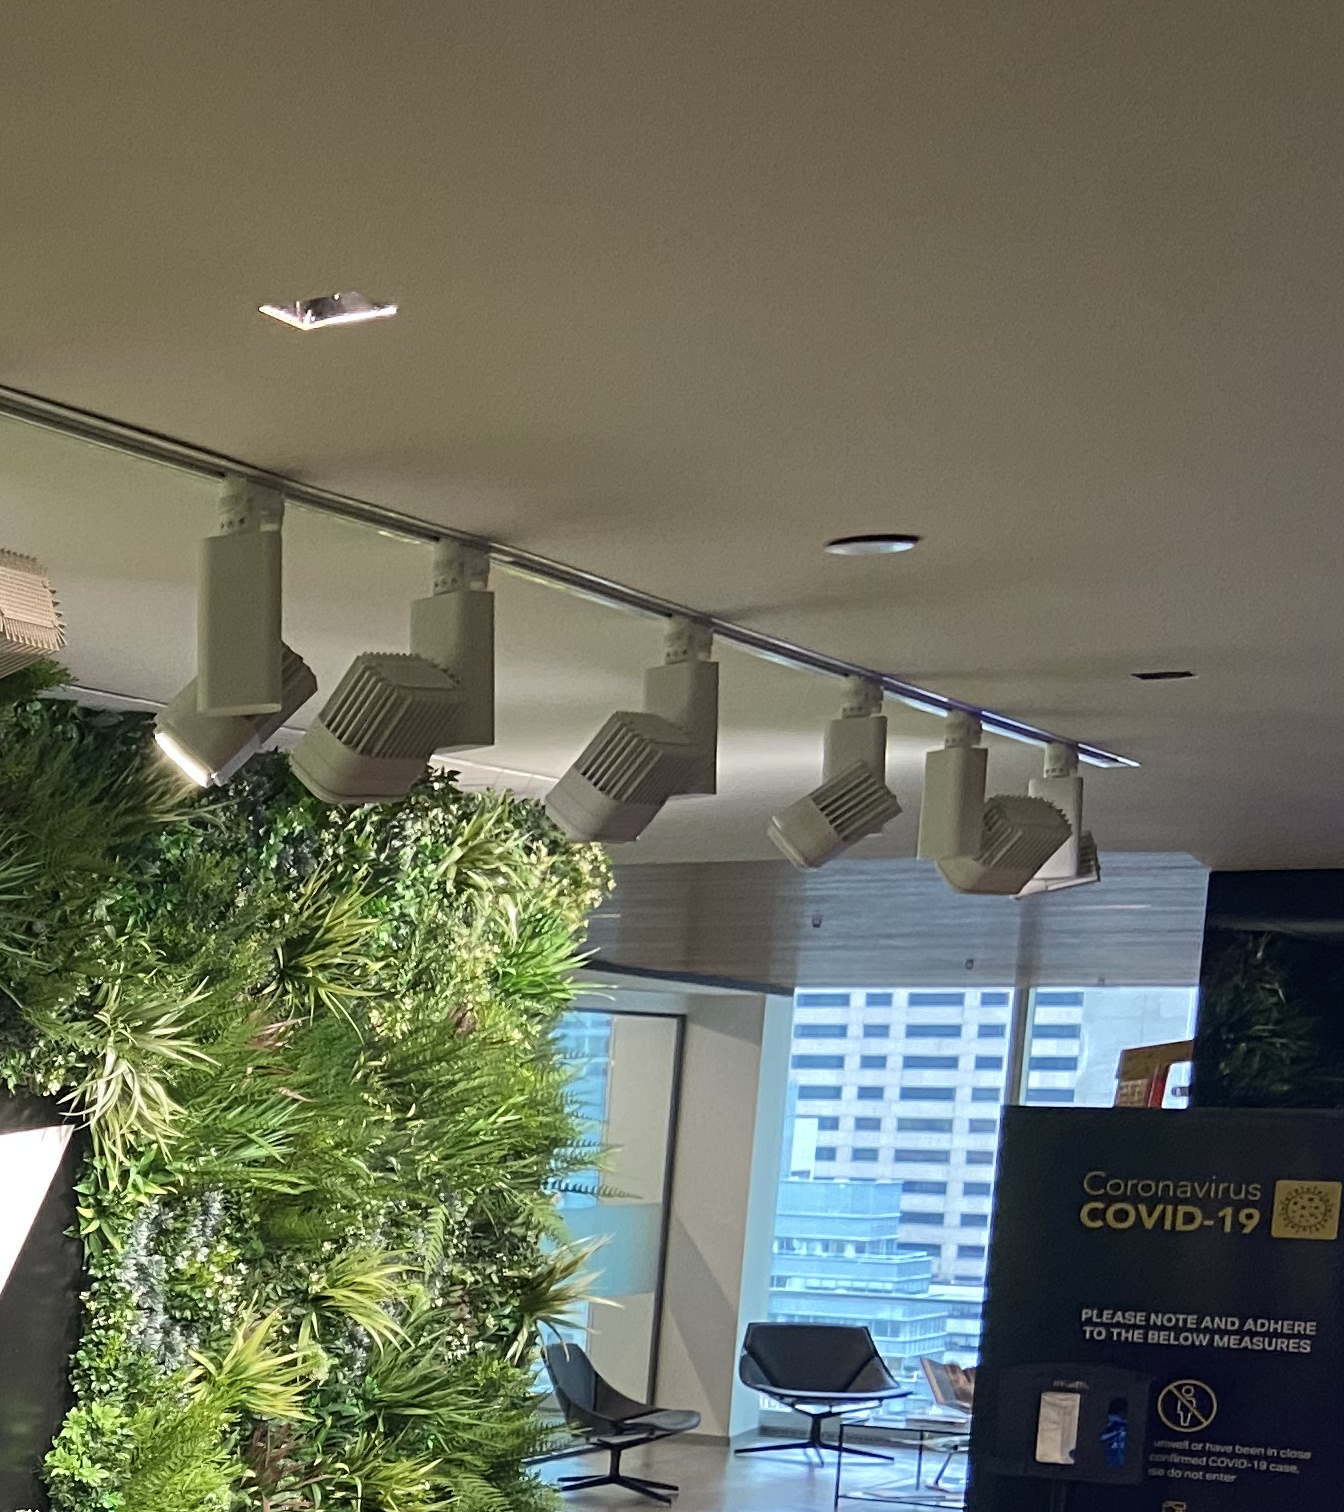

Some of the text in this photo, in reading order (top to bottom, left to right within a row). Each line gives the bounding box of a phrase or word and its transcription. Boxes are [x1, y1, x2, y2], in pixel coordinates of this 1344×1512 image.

[1082, 1171, 1261, 1200] Coronavirus
[1080, 1202, 1260, 1234] COVID-19
[1081, 1309, 1317, 1335] PLEASE NOTE AND ADHERE
[1082, 1326, 1312, 1353] TO THE BELOW MEASURES
[1149, 1453, 1207, 1466] confirmed
[1208, 1456, 1267, 1470] COVID-19
[1190, 1443, 1204, 1451] or
[1205, 1442, 1233, 1453] have
[1234, 1445, 1265, 1456] been
[1266, 1447, 1278, 1457] in
[1279, 1448, 1312, 1460] close
[1166, 1468, 1182, 1478] do
[1183, 1470, 1204, 1480] not
[1205, 1471, 1237, 1483] enter
